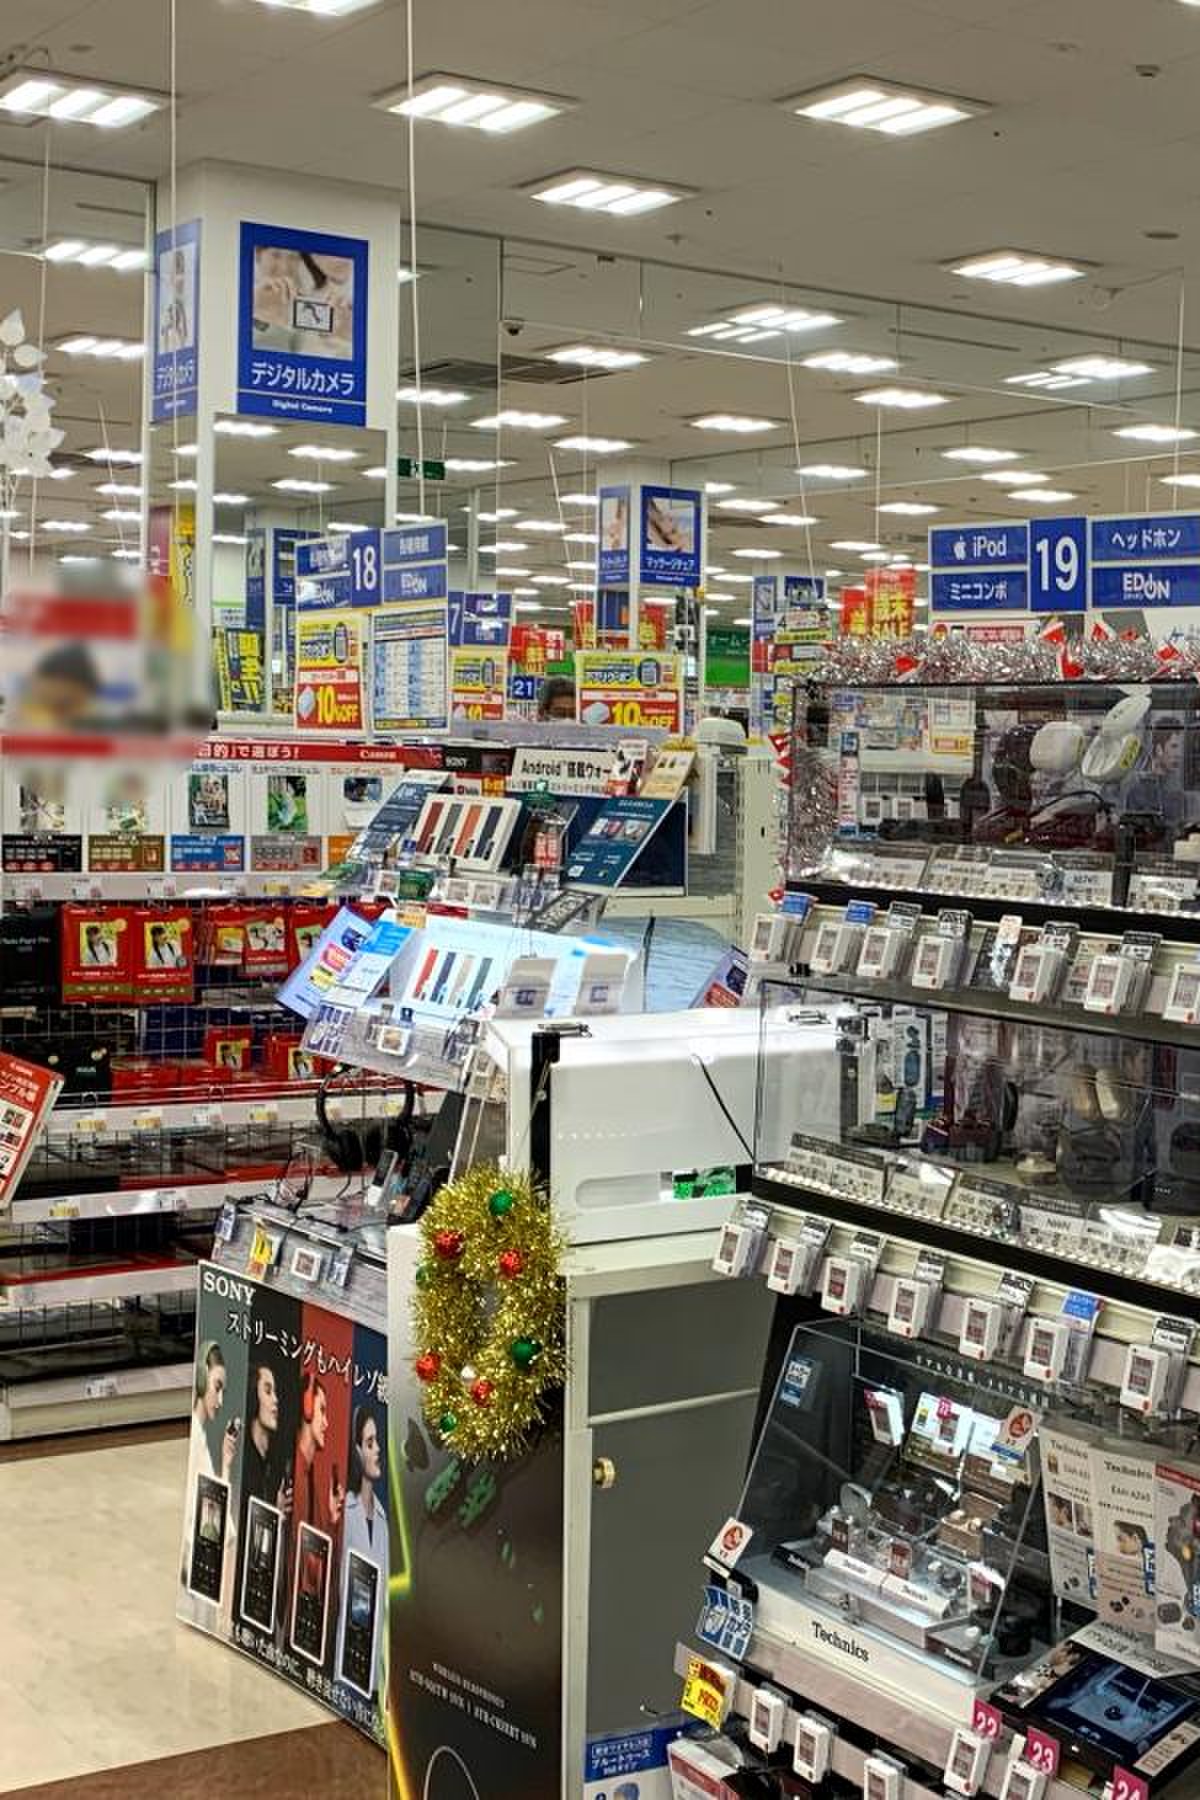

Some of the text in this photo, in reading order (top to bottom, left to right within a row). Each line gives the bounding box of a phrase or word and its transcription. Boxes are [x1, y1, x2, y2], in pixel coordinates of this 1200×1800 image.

[251, 361, 355, 395] デジタルカメラ
[973, 536, 1008, 558] iPod
[1111, 528, 1182, 551] ヘッドホン
[352, 545, 377, 591] 18
[1035, 536, 1079, 593] 19
[950, 581, 1009, 601] ミニコンポ
[513, 680, 534, 697] 21
[359, 749, 397, 760] Canon
[203, 1271, 256, 1306] SONY
[812, 1620, 870, 1664] Technics
[976, 1710, 998, 1742] 22
[1032, 1740, 1054, 1778] 23
